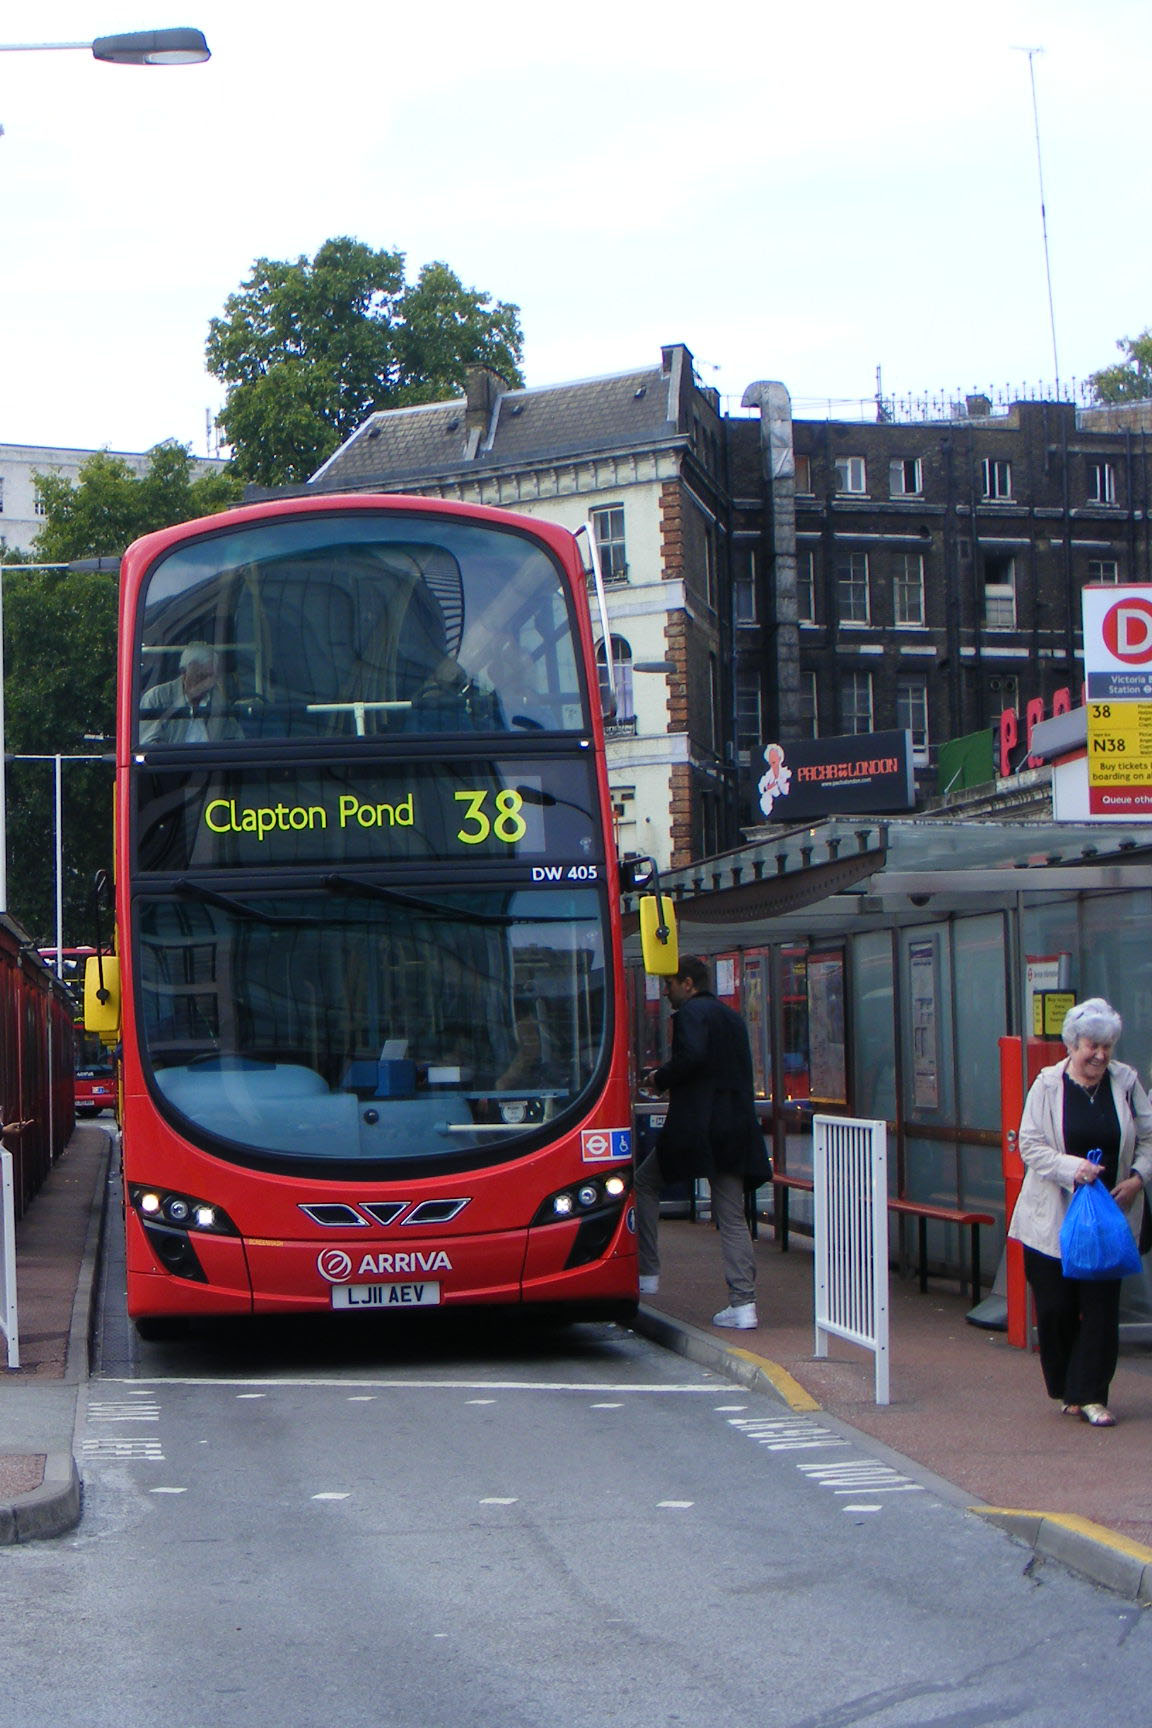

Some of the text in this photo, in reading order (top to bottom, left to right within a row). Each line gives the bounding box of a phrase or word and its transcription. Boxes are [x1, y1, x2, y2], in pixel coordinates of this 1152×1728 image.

[1117, 608, 1152, 654] D
[1111, 675, 1146, 684] Victoria
[1108, 685, 1141, 694] Station
[1092, 705, 1111, 718] 38
[1093, 738, 1126, 752] N38
[797, 758, 898, 782] PACHA LONDON
[1100, 762, 1148, 771] Buy tickets
[1092, 773, 1130, 781] boarding
[1102, 795, 1132, 804] Queue
[204, 788, 528, 845] Clapton Pond 38
[532, 865, 598, 881] DW 405
[357, 1251, 453, 1275] ARRIVA
[388, 1285, 425, 1303] AEV
